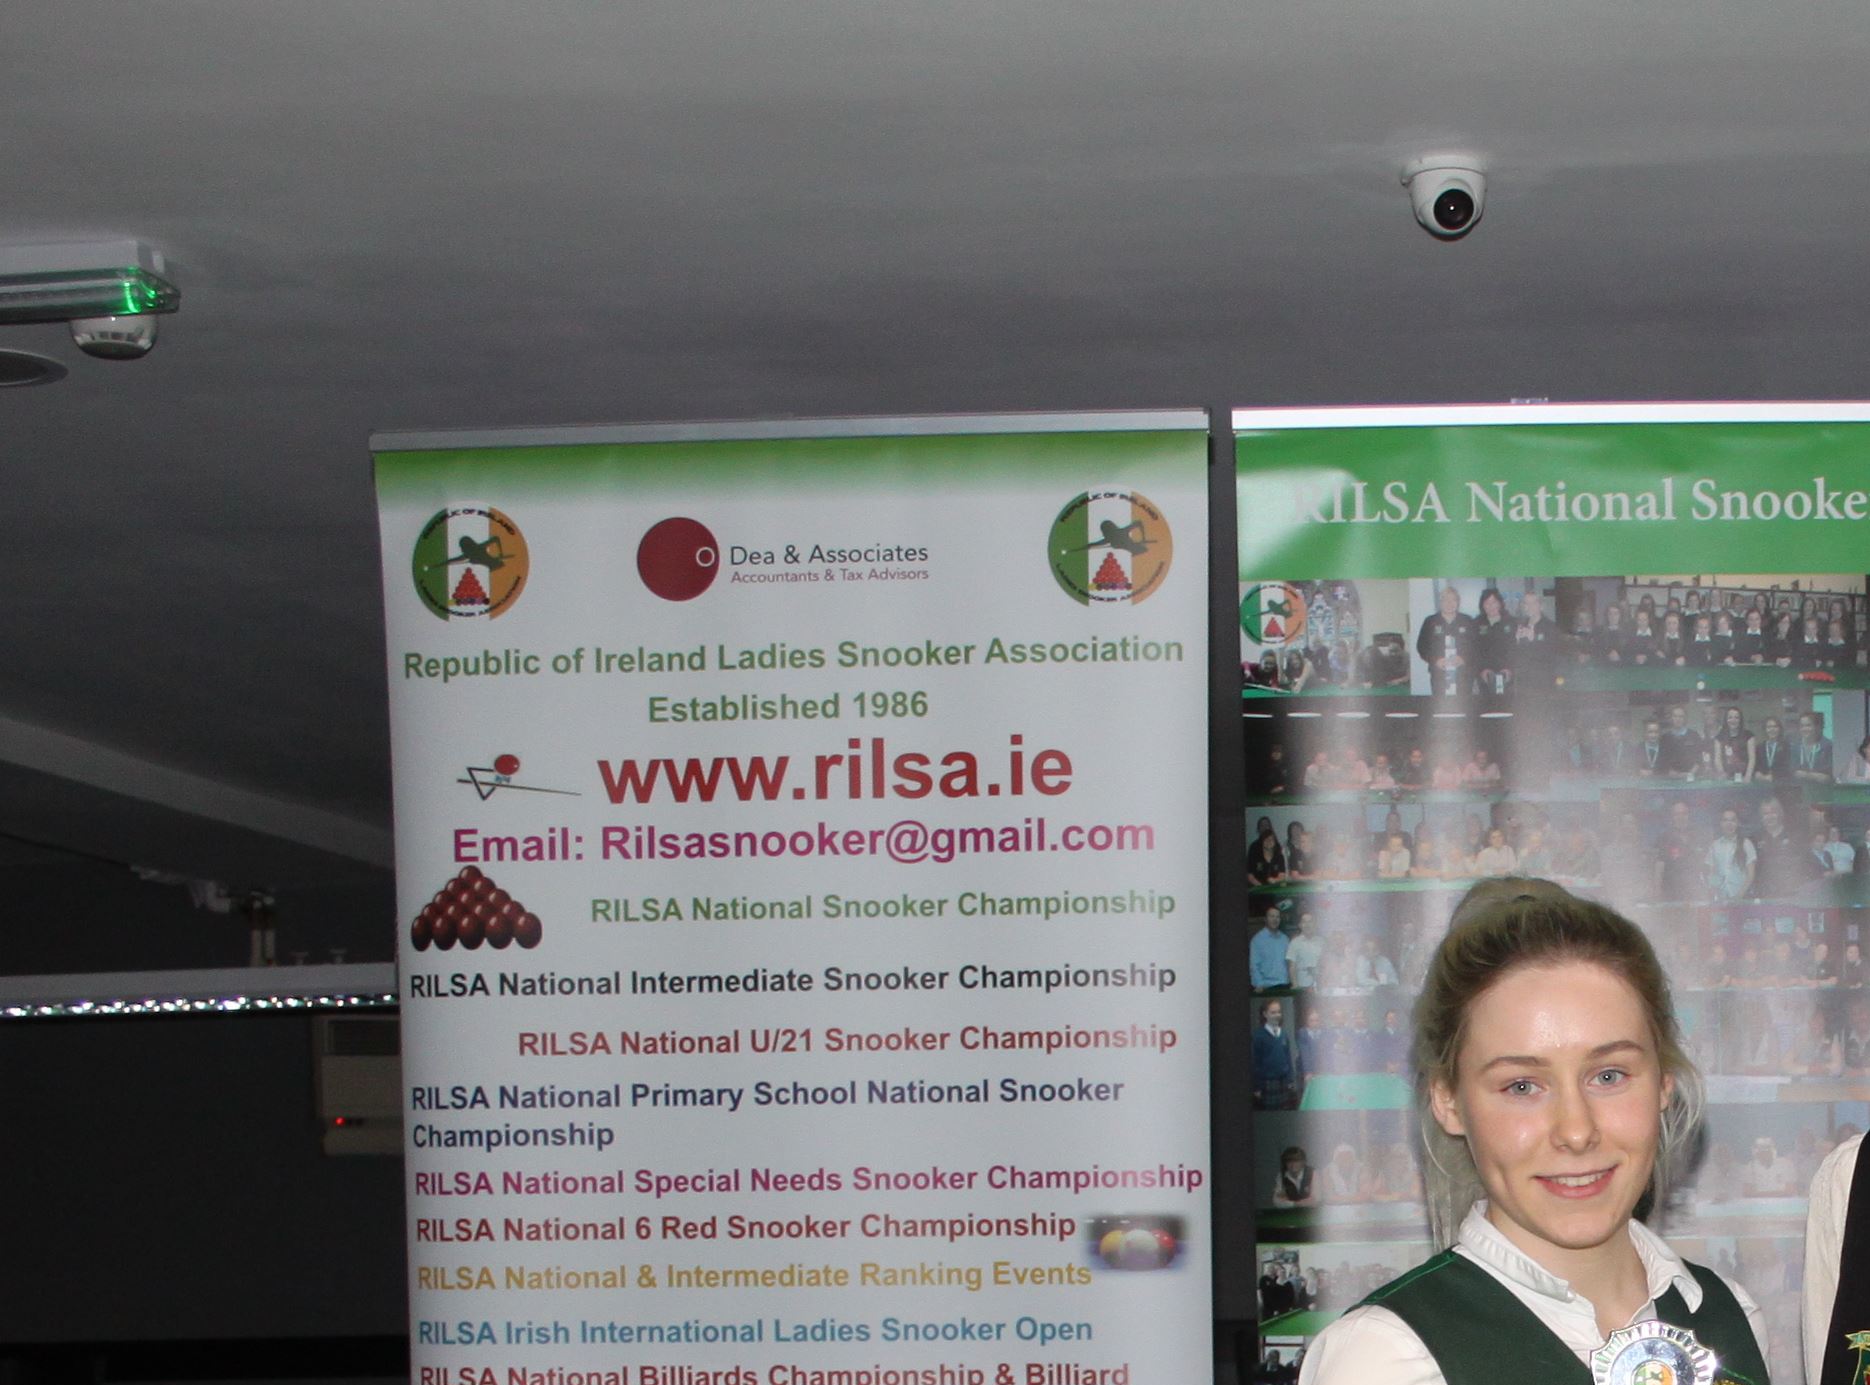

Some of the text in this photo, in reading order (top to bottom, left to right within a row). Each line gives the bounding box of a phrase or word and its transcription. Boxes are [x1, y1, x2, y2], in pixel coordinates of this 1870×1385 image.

[1291, 480, 1450, 524] RILSA
[1466, 477, 1677, 523] National
[731, 545, 929, 566] Dea & Associates
[731, 568, 930, 584] Accountants & Tax Advisors
[404, 636, 1183, 683] Republic of Ireland Ladies Snooker Association
[649, 691, 929, 723] Established 1986
[597, 734, 1073, 805] www.rilsa.ie
[453, 818, 1154, 865] Email: Rilsasnooker@gmail.com
[592, 891, 1176, 923] RILSA National Snooker Championship
[410, 964, 1177, 999] RILSA National Intermediate Snooker Championship
[518, 1024, 1178, 1057] RILSA National U/21 Snooker Championship
[411, 1078, 1124, 1113] RILSA National Primary School National Snooker
[412, 1122, 615, 1153] Championship
[414, 1164, 1204, 1200] RILSA National Special Needs Snooker Championship
[415, 1212, 1076, 1244] RILSA National 6 Red Snooker Championship
[417, 1259, 1094, 1292] RILSA National & Intermediate Ranking Events
[418, 1317, 1093, 1347] RILSA Irish International Ladies Snooker Open
